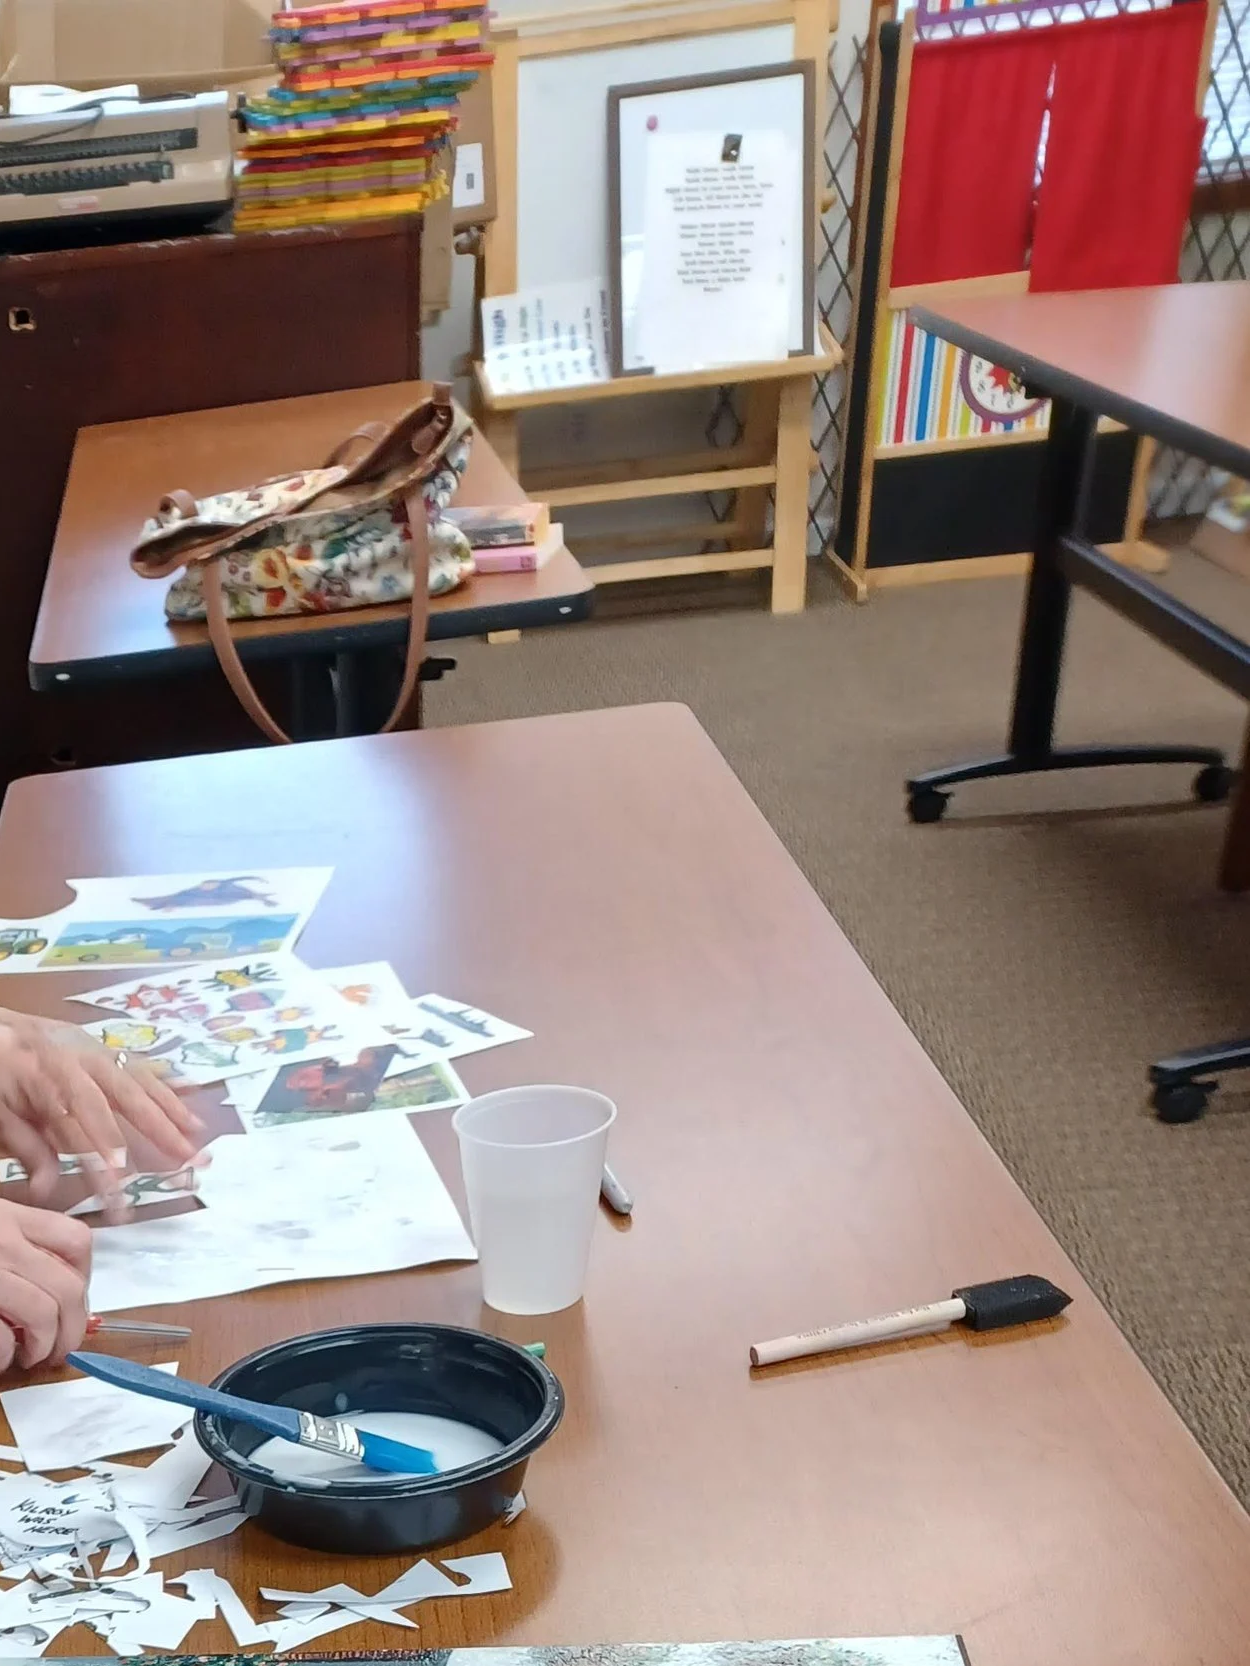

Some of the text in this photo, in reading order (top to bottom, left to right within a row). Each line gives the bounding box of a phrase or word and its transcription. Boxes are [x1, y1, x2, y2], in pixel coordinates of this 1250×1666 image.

[11, 1498, 78, 1516] KILROY
[18, 1515, 57, 1525] WAS
[23, 1526, 79, 1536] HERE
